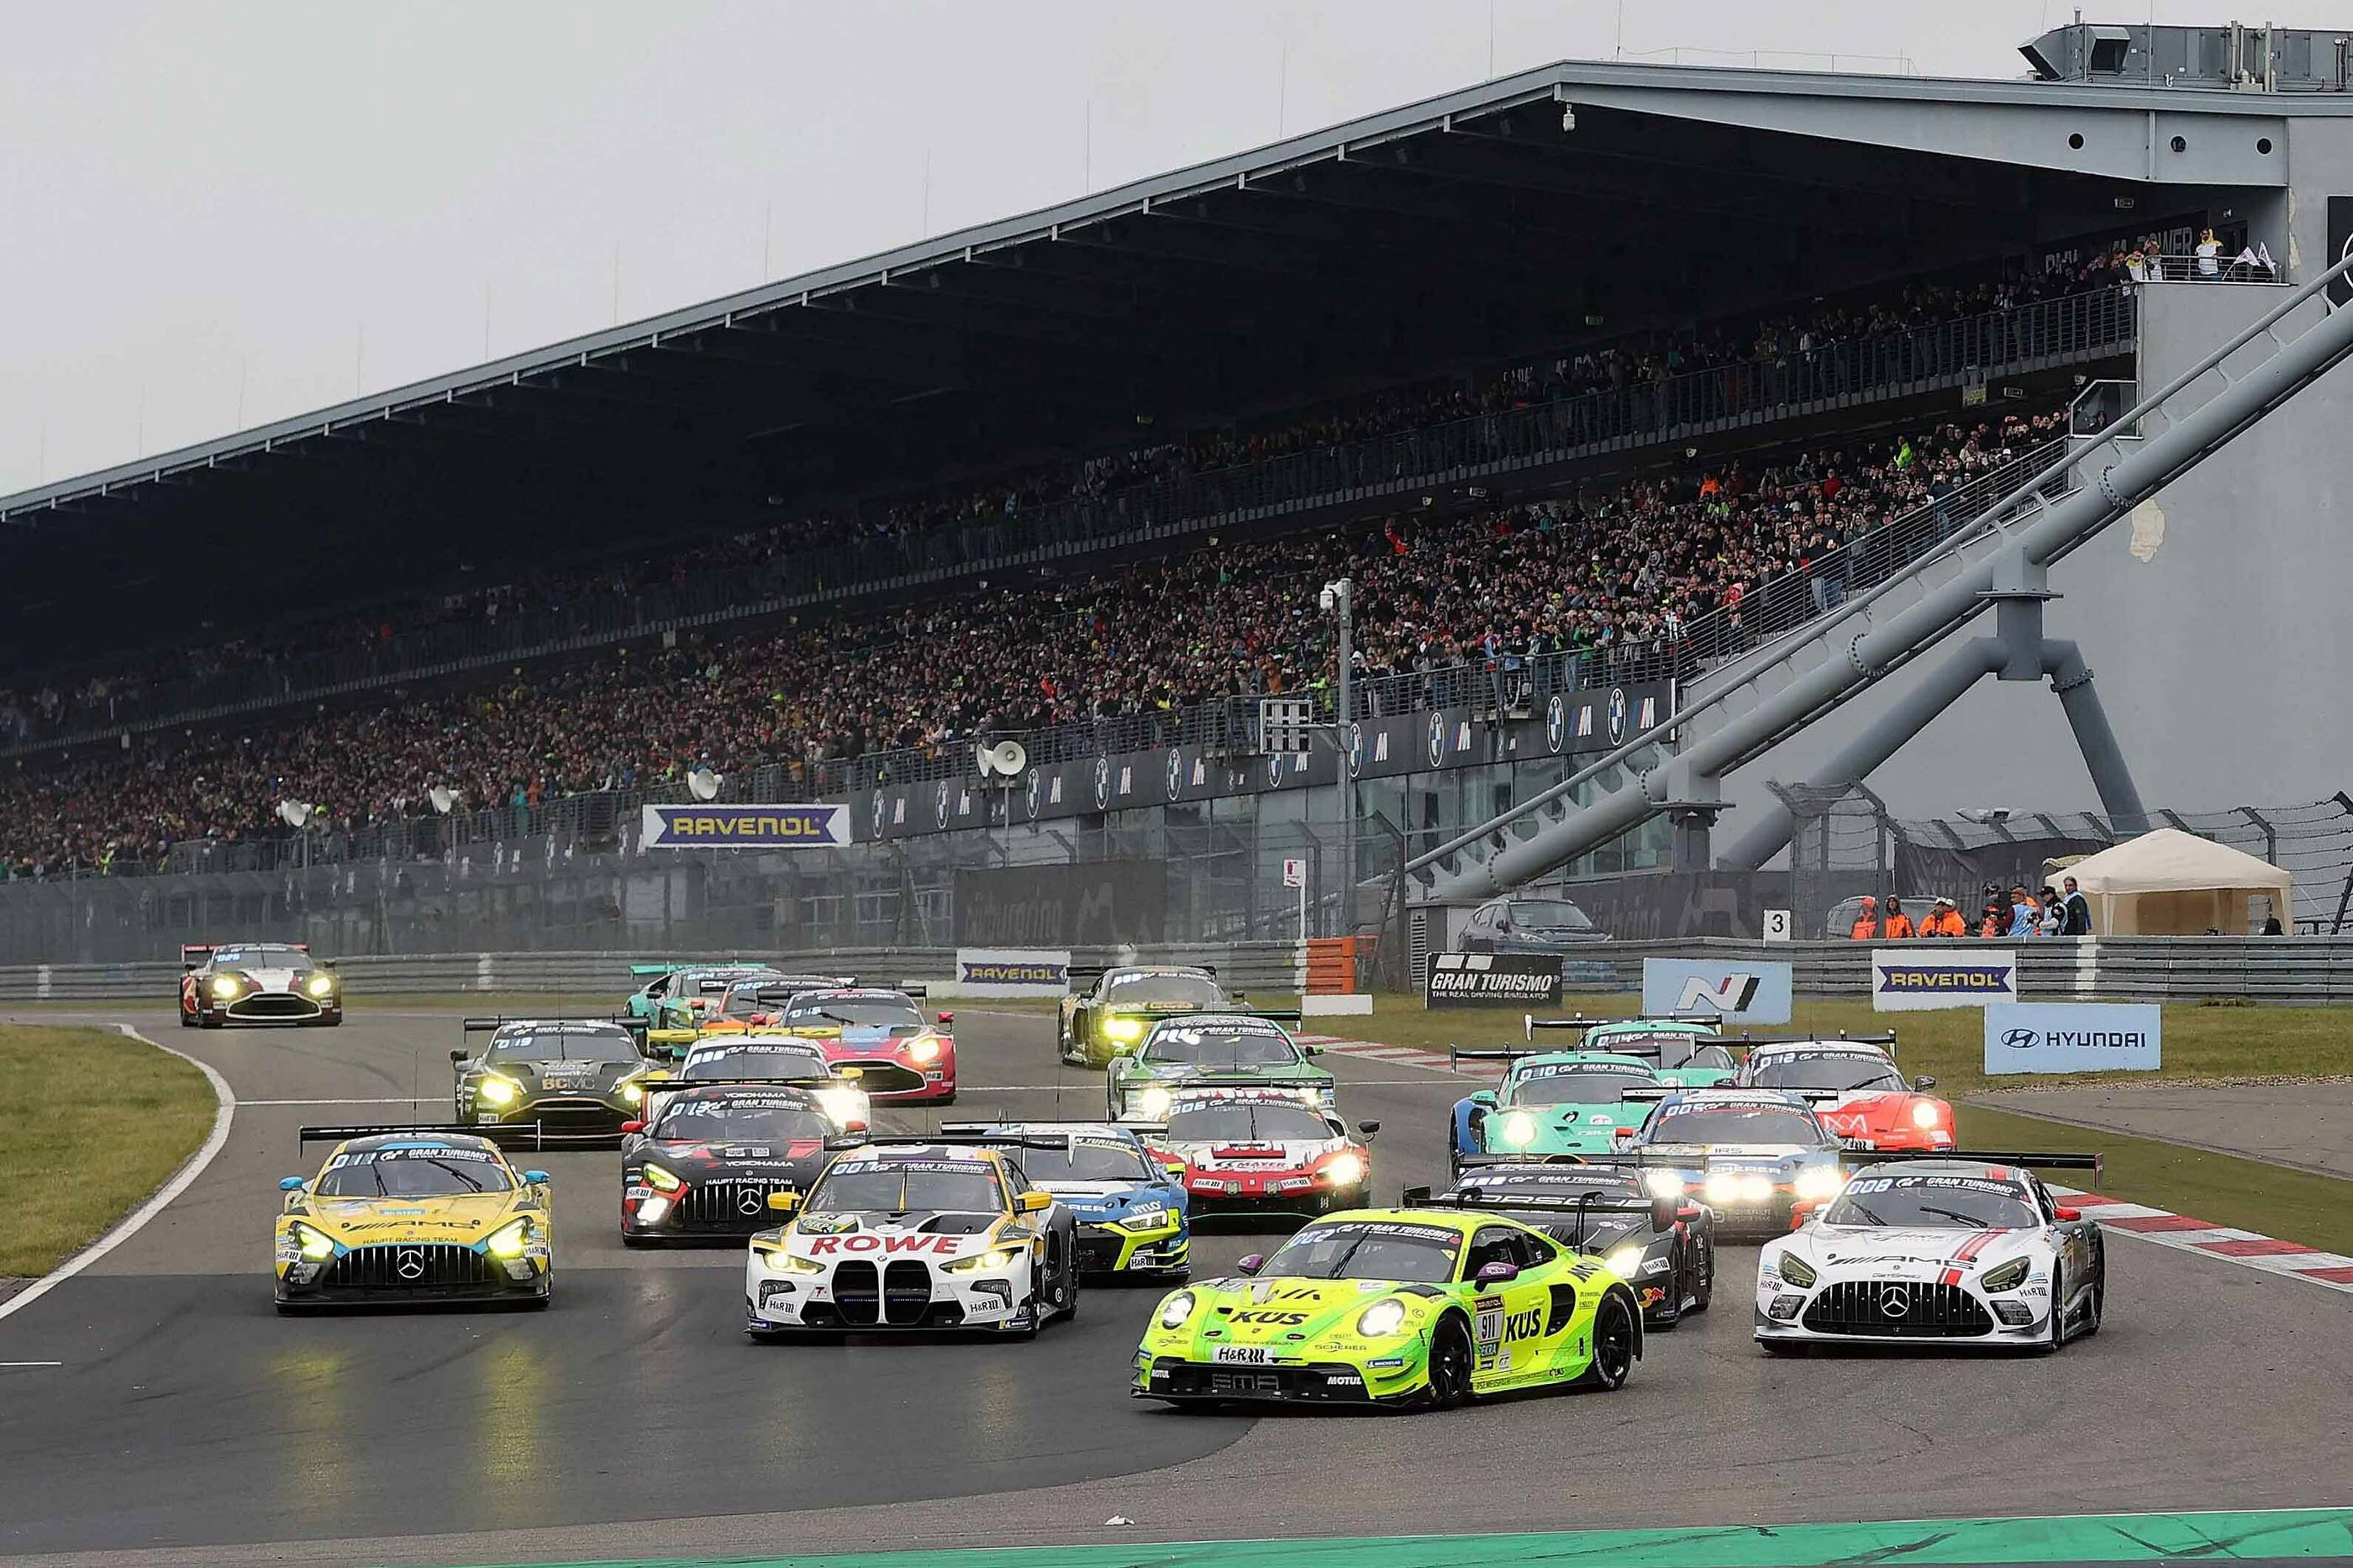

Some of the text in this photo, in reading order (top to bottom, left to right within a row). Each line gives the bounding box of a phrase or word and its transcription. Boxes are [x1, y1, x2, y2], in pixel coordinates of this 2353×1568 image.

[673, 817, 821, 836] RAVENOL
[1771, 913, 1784, 933] 3
[971, 967, 1056, 980] RAVENOL
[1891, 972, 2000, 987] RAVENOL
[1431, 973, 1478, 991] GRAN
[2046, 1032, 2146, 1048] HYUNDAI
[731, 1100, 761, 1108] GRAN
[761, 1100, 803, 1110] TURISMO
[408, 1149, 440, 1157] GRAN
[440, 1149, 487, 1160] TURISMO
[936, 1163, 986, 1172] TURISMO
[1845, 1178, 1893, 1195] 008
[1926, 1177, 1960, 1186] GRAN
[1961, 1178, 2013, 1194] TURISMO
[1129, 1202, 1161, 1215] HYLO
[1398, 1225, 1455, 1239] TURISMO
[809, 1234, 965, 1255] ROWE
[1229, 1311, 1309, 1325] KÜS
[1504, 1308, 1542, 1343] KÜS
[1482, 1313, 1496, 1339] 911
[1327, 1376, 1363, 1385] MOTUL
